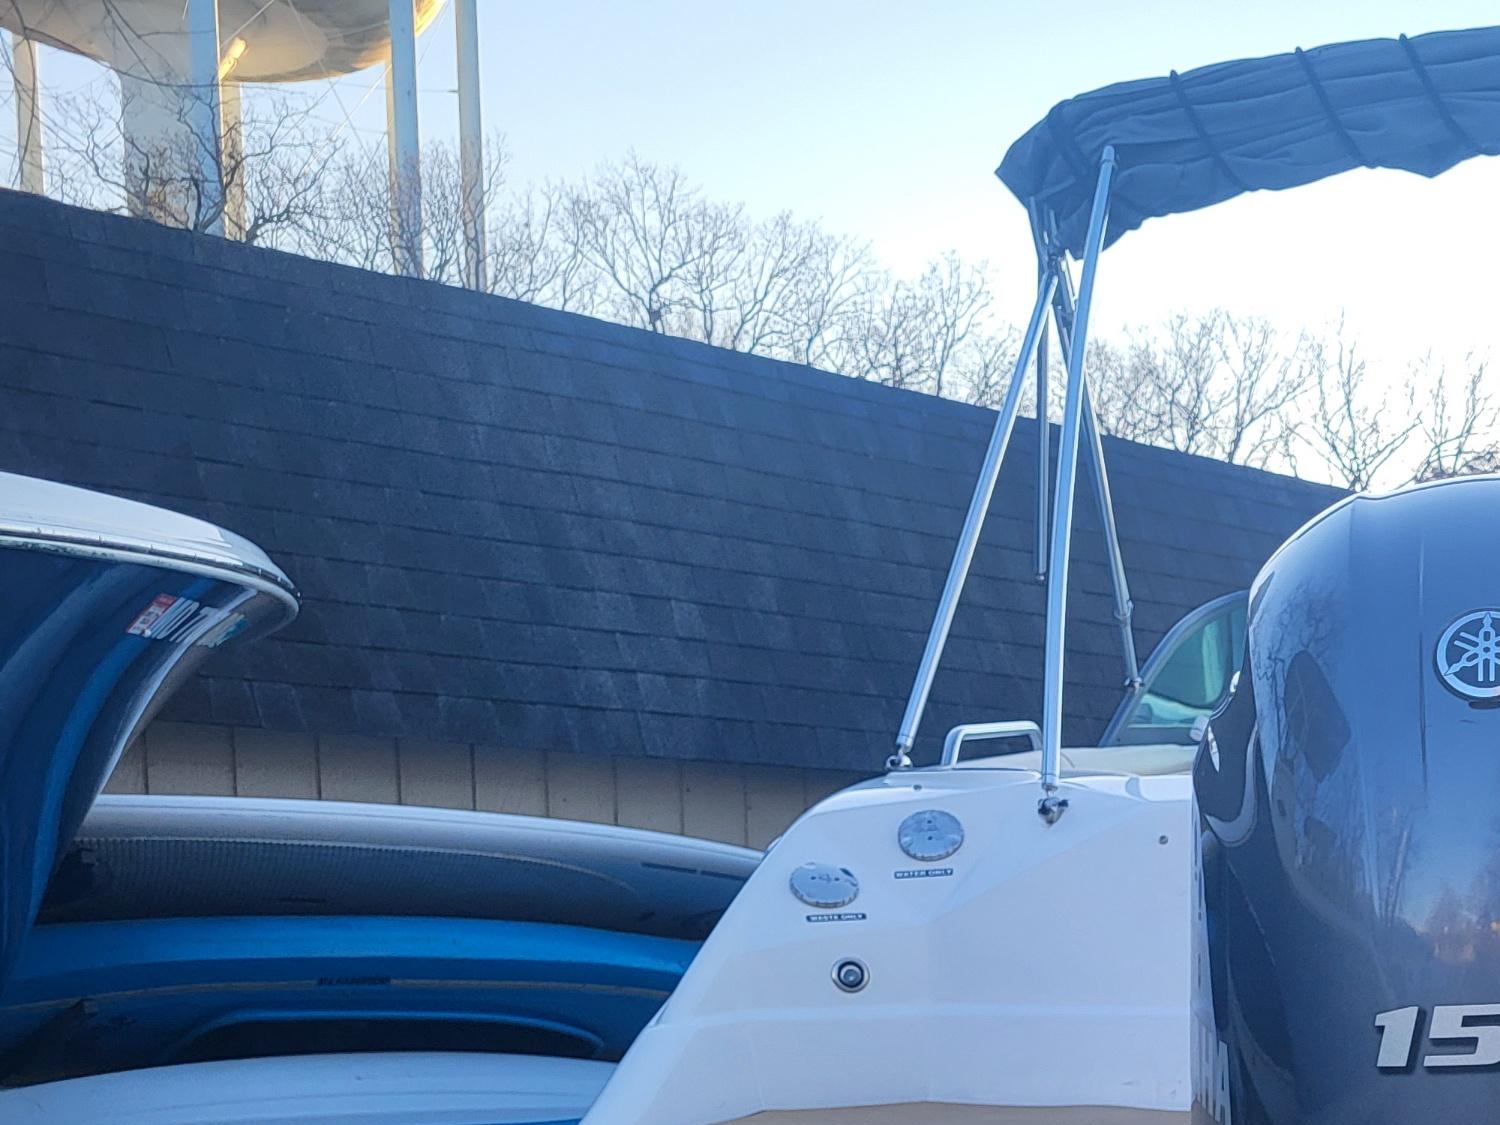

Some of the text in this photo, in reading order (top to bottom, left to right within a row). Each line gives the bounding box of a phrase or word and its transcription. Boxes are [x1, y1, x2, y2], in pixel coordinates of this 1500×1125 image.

[895, 868, 953, 879] WATER ONLY
[810, 912, 864, 922] WASTE ONLY
